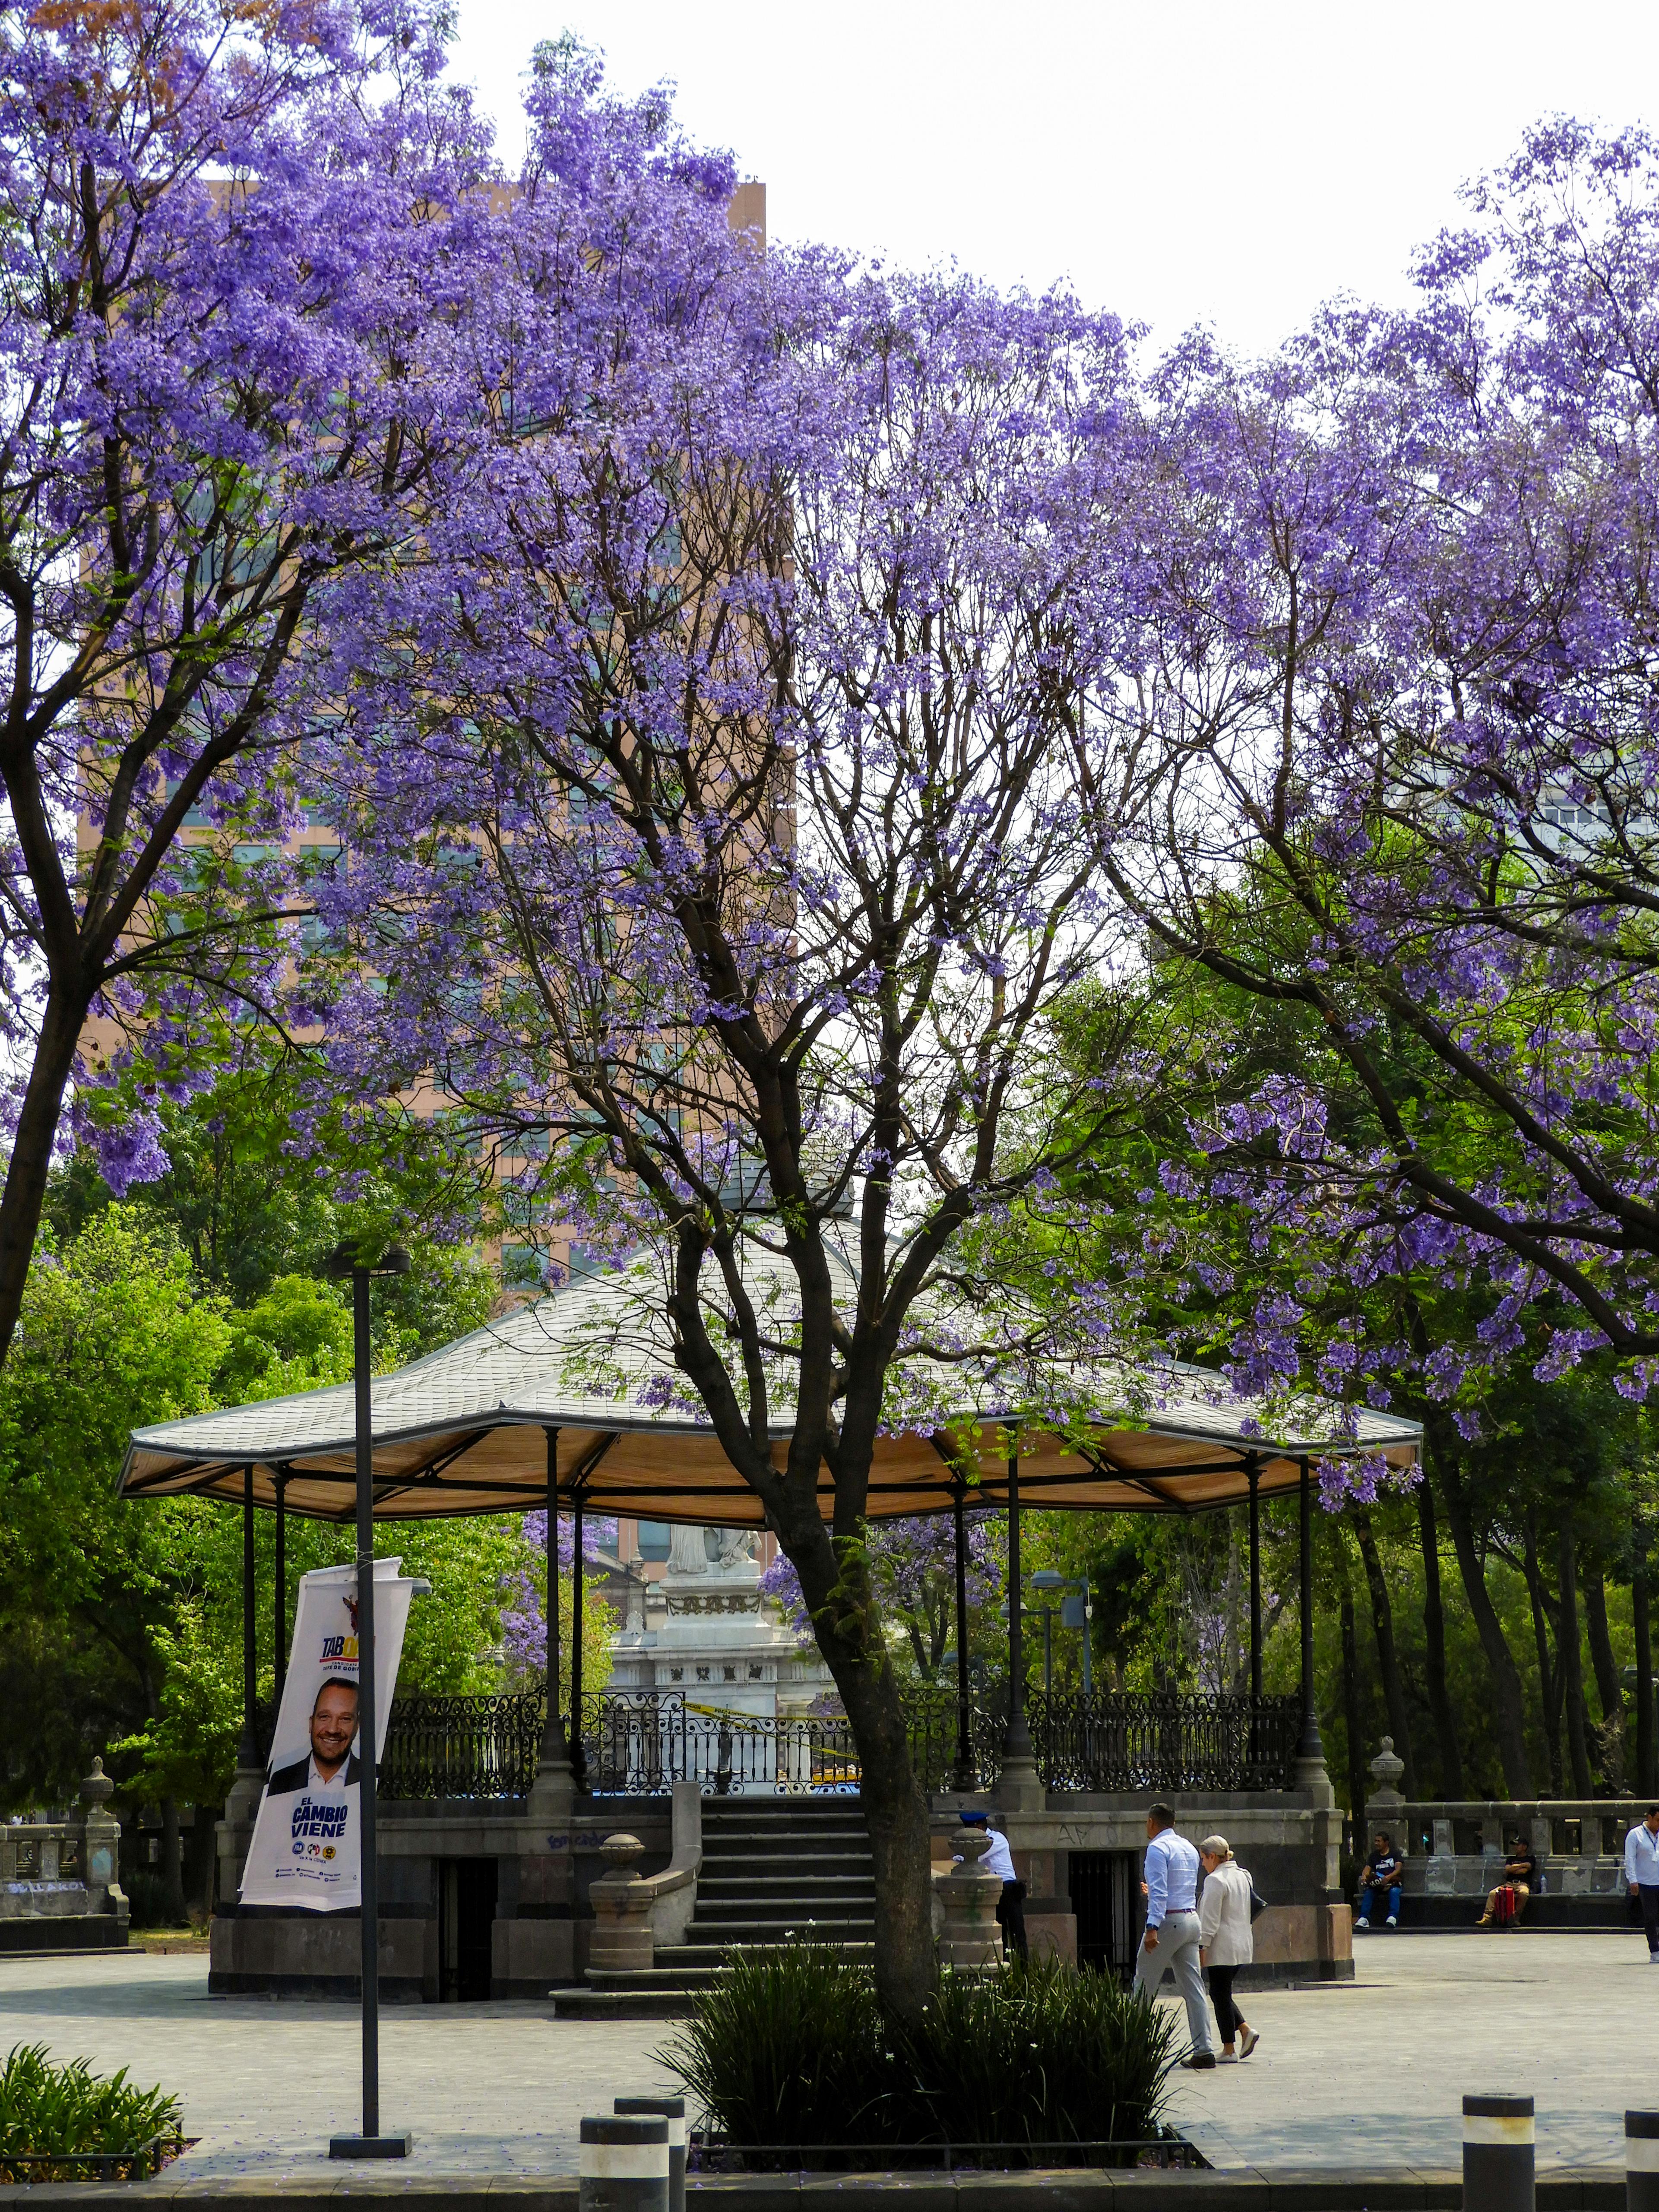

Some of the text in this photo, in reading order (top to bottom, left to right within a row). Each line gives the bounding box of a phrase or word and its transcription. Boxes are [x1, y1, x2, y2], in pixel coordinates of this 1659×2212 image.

[301, 1797, 313, 1806] EL
[293, 1805, 348, 1823] CAMBIO
[292, 1822, 346, 1838] VIENE
